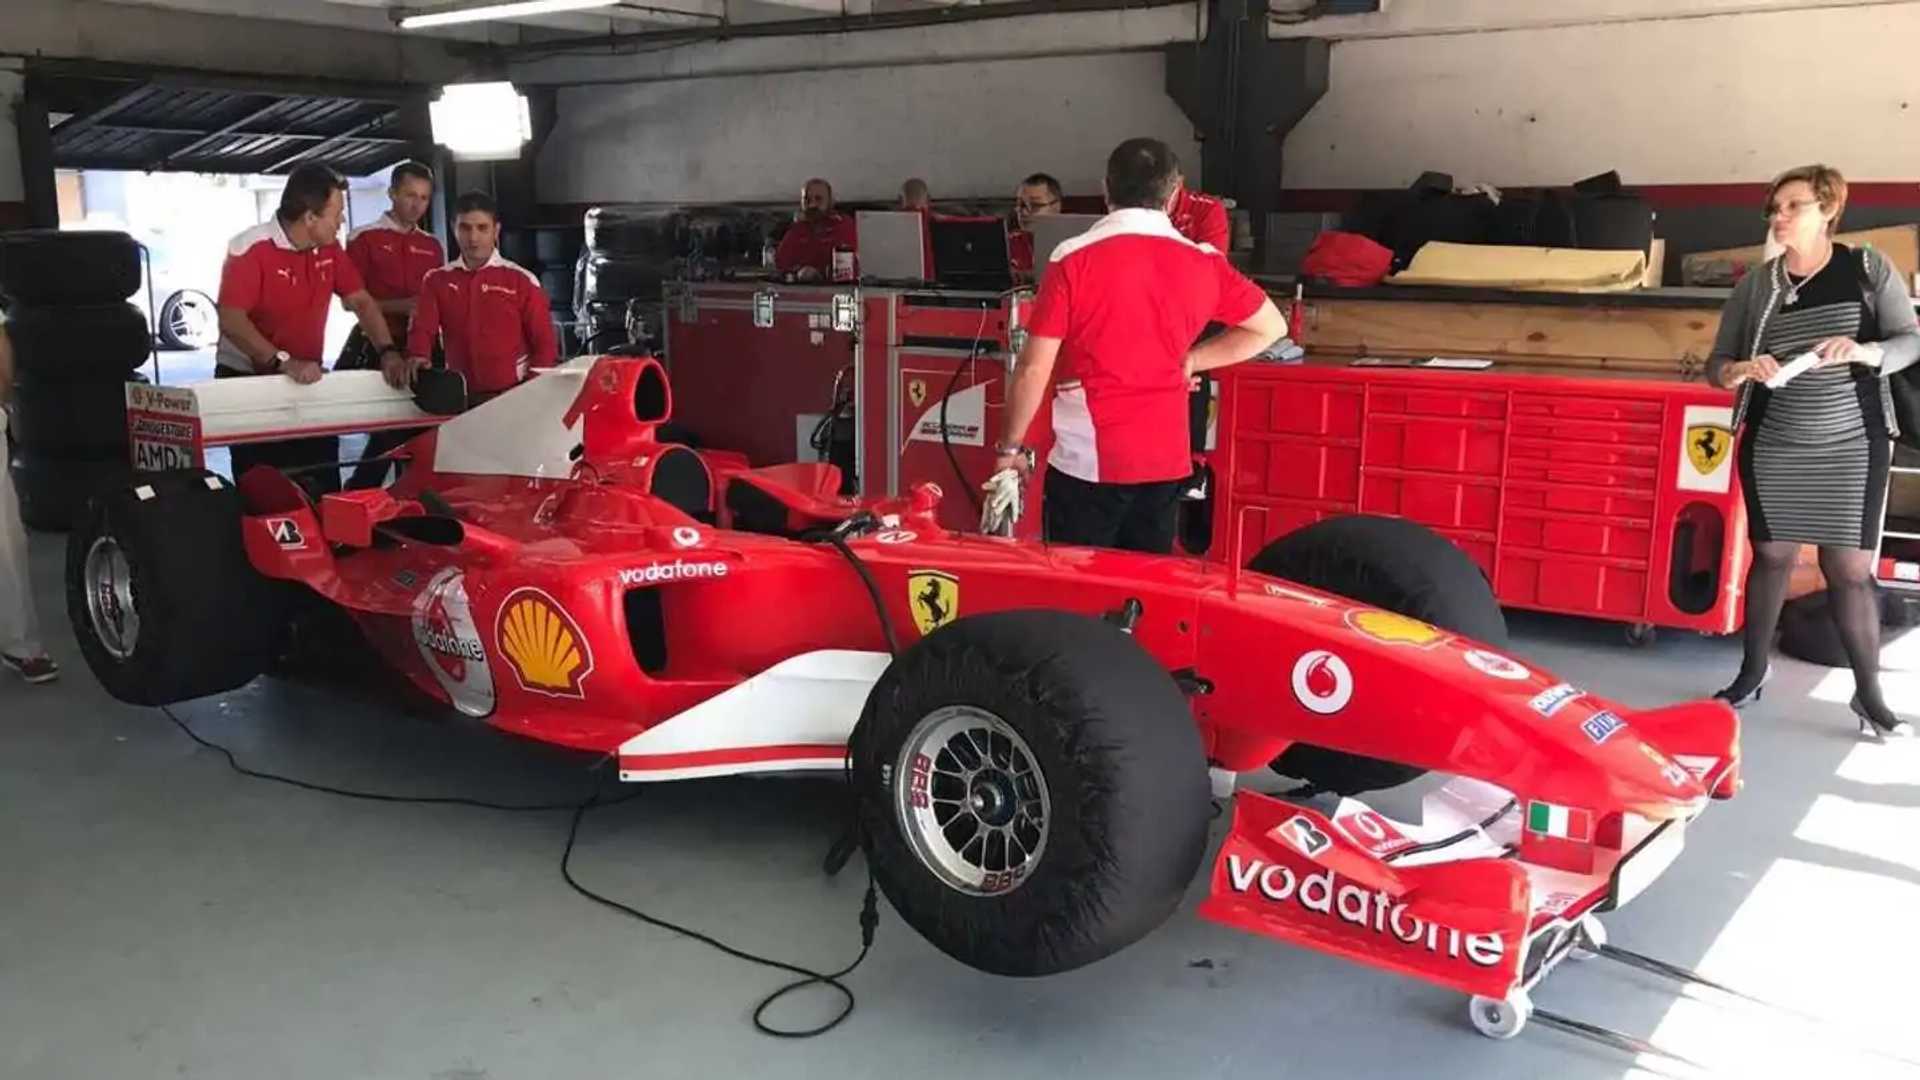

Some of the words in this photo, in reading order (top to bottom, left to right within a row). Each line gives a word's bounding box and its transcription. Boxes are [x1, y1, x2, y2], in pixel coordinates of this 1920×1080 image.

[146, 390, 192, 411] V-Power
[136, 443, 177, 470] AMD
[619, 559, 728, 583] vodafone
[1228, 853, 1504, 965] vodafone
